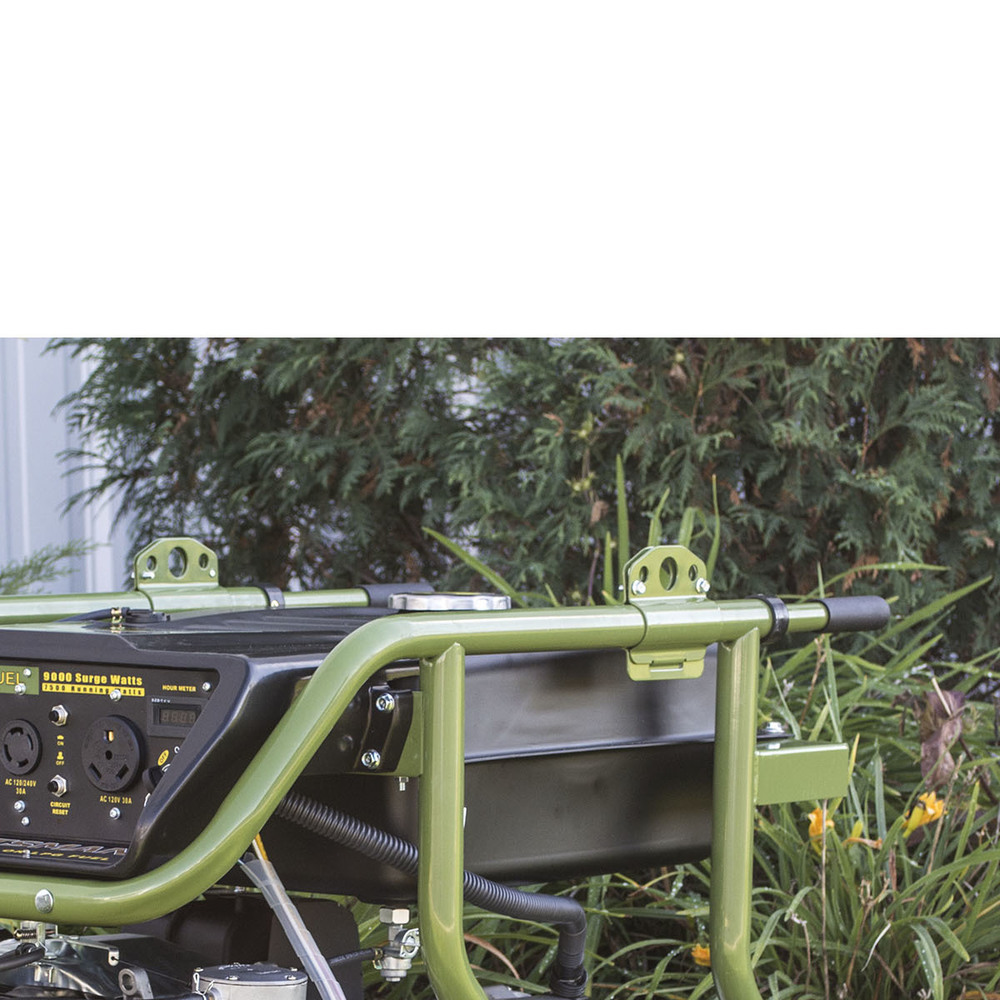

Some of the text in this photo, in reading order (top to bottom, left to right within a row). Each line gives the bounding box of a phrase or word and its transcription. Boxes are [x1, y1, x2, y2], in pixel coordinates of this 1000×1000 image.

[43, 671, 143, 686] 9000 Surge Watts
[162, 684, 178, 692] HOUR
[5, 778, 13, 786] AC
[100, 795, 107, 803] AC
[108, 796, 121, 804] 120V
[50, 801, 71, 809] CIRCUIT
[52, 808, 69, 816] RESET
